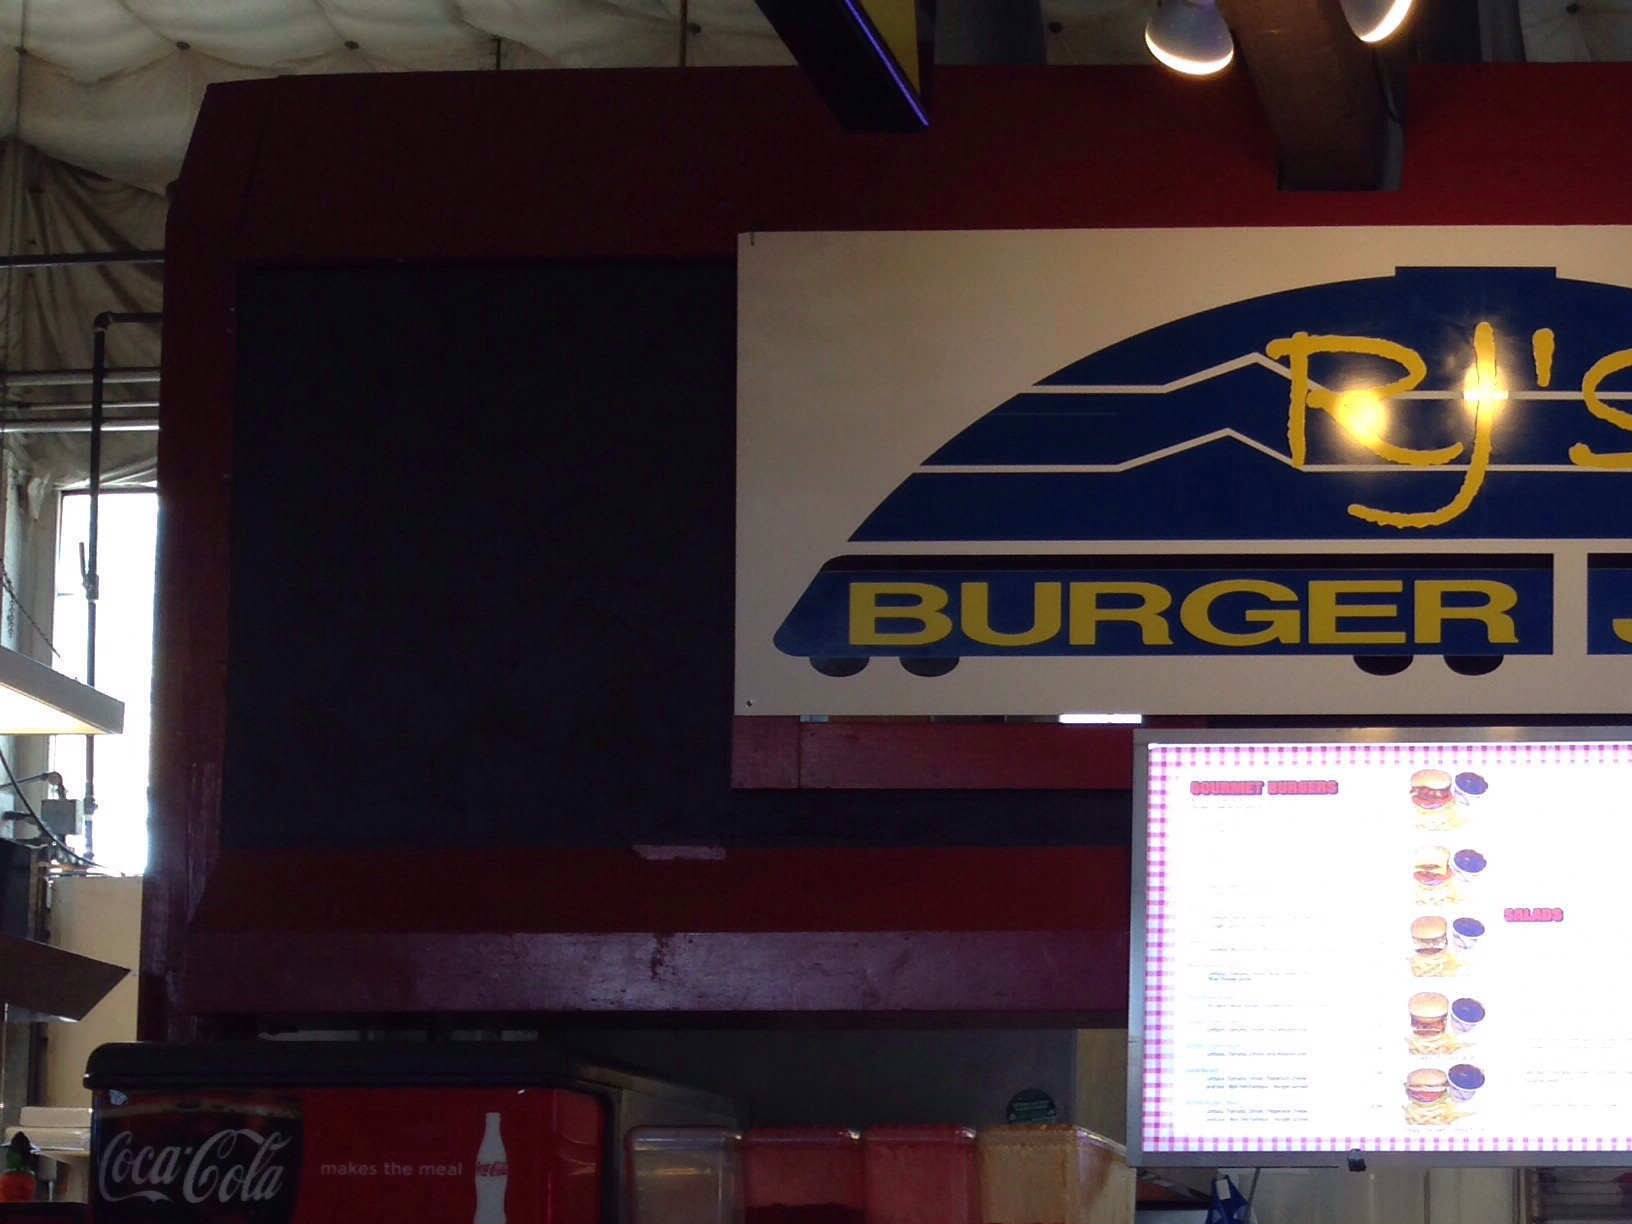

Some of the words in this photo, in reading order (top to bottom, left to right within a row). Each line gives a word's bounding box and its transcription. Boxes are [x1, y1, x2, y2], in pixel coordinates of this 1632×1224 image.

[847, 577, 1521, 647] BURGER
[99, 1127, 292, 1204] Coca-Cola
[320, 1161, 379, 1177] makes
[383, 1161, 414, 1177] the
[418, 1161, 463, 1177] meal
